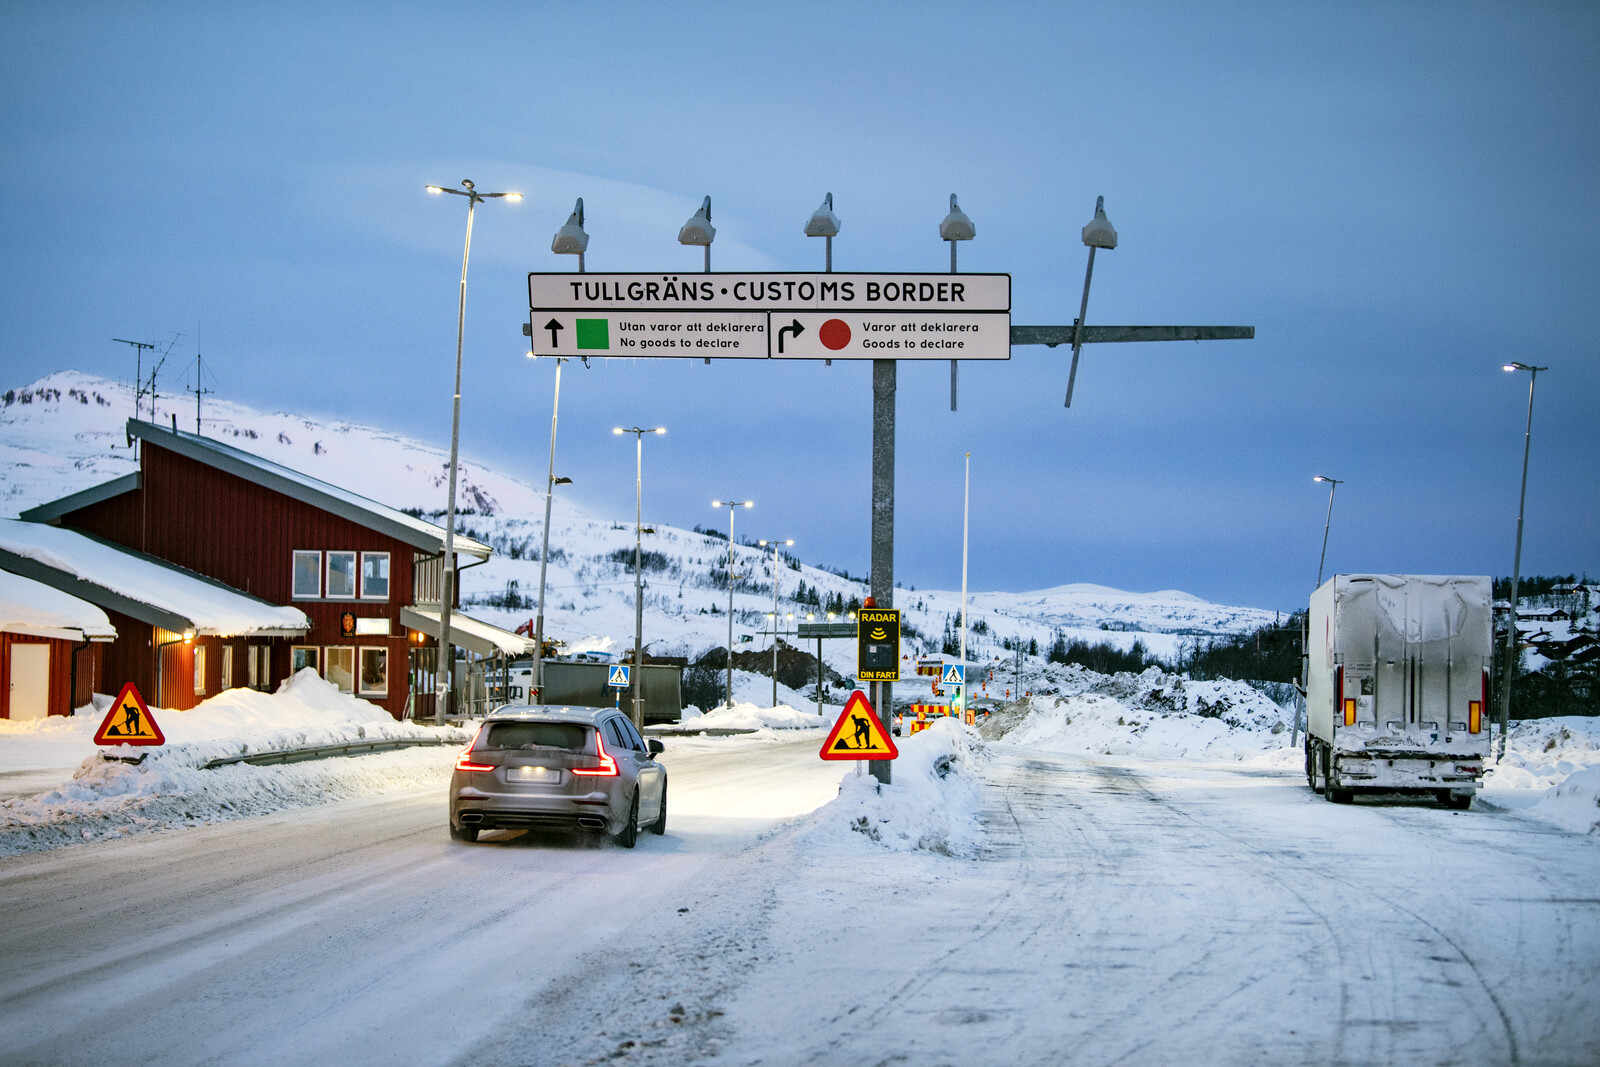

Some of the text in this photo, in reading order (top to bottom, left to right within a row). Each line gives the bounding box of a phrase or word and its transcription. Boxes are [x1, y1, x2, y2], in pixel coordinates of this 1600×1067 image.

[570, 276, 964, 301] TULLGRÄNS CUSTOMS BORDER
[620, 322, 645, 331] Utan
[687, 323, 701, 331] att
[707, 323, 763, 332] deklarera
[863, 323, 978, 332] Varor att deklarera
[621, 338, 739, 349] No goods to declare
[863, 339, 964, 348] Goods to declare
[861, 613, 896, 622] RADAR
[860, 671, 896, 679] DIN FART
